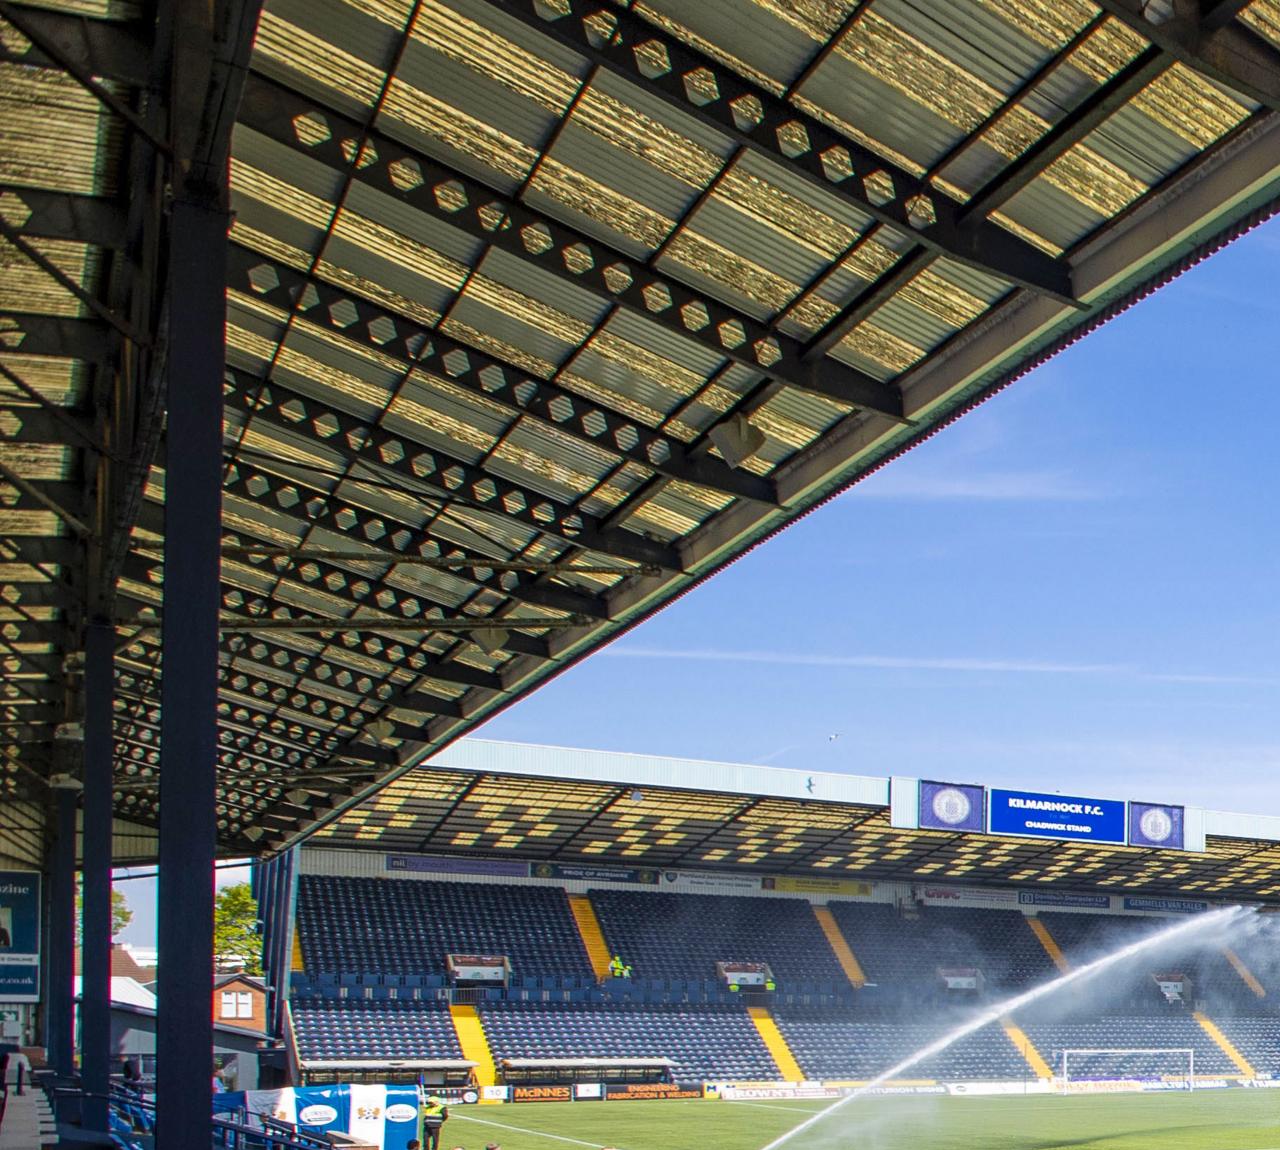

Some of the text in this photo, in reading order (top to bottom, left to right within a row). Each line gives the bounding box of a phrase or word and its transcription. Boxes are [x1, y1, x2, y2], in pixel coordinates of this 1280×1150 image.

[1008, 798, 1104, 816] KILMARNOCK F.C.
[1025, 821, 1092, 833] CHADWICK STAND
[0, 884, 29, 894] zine
[515, 1087, 570, 1097] McINNES
